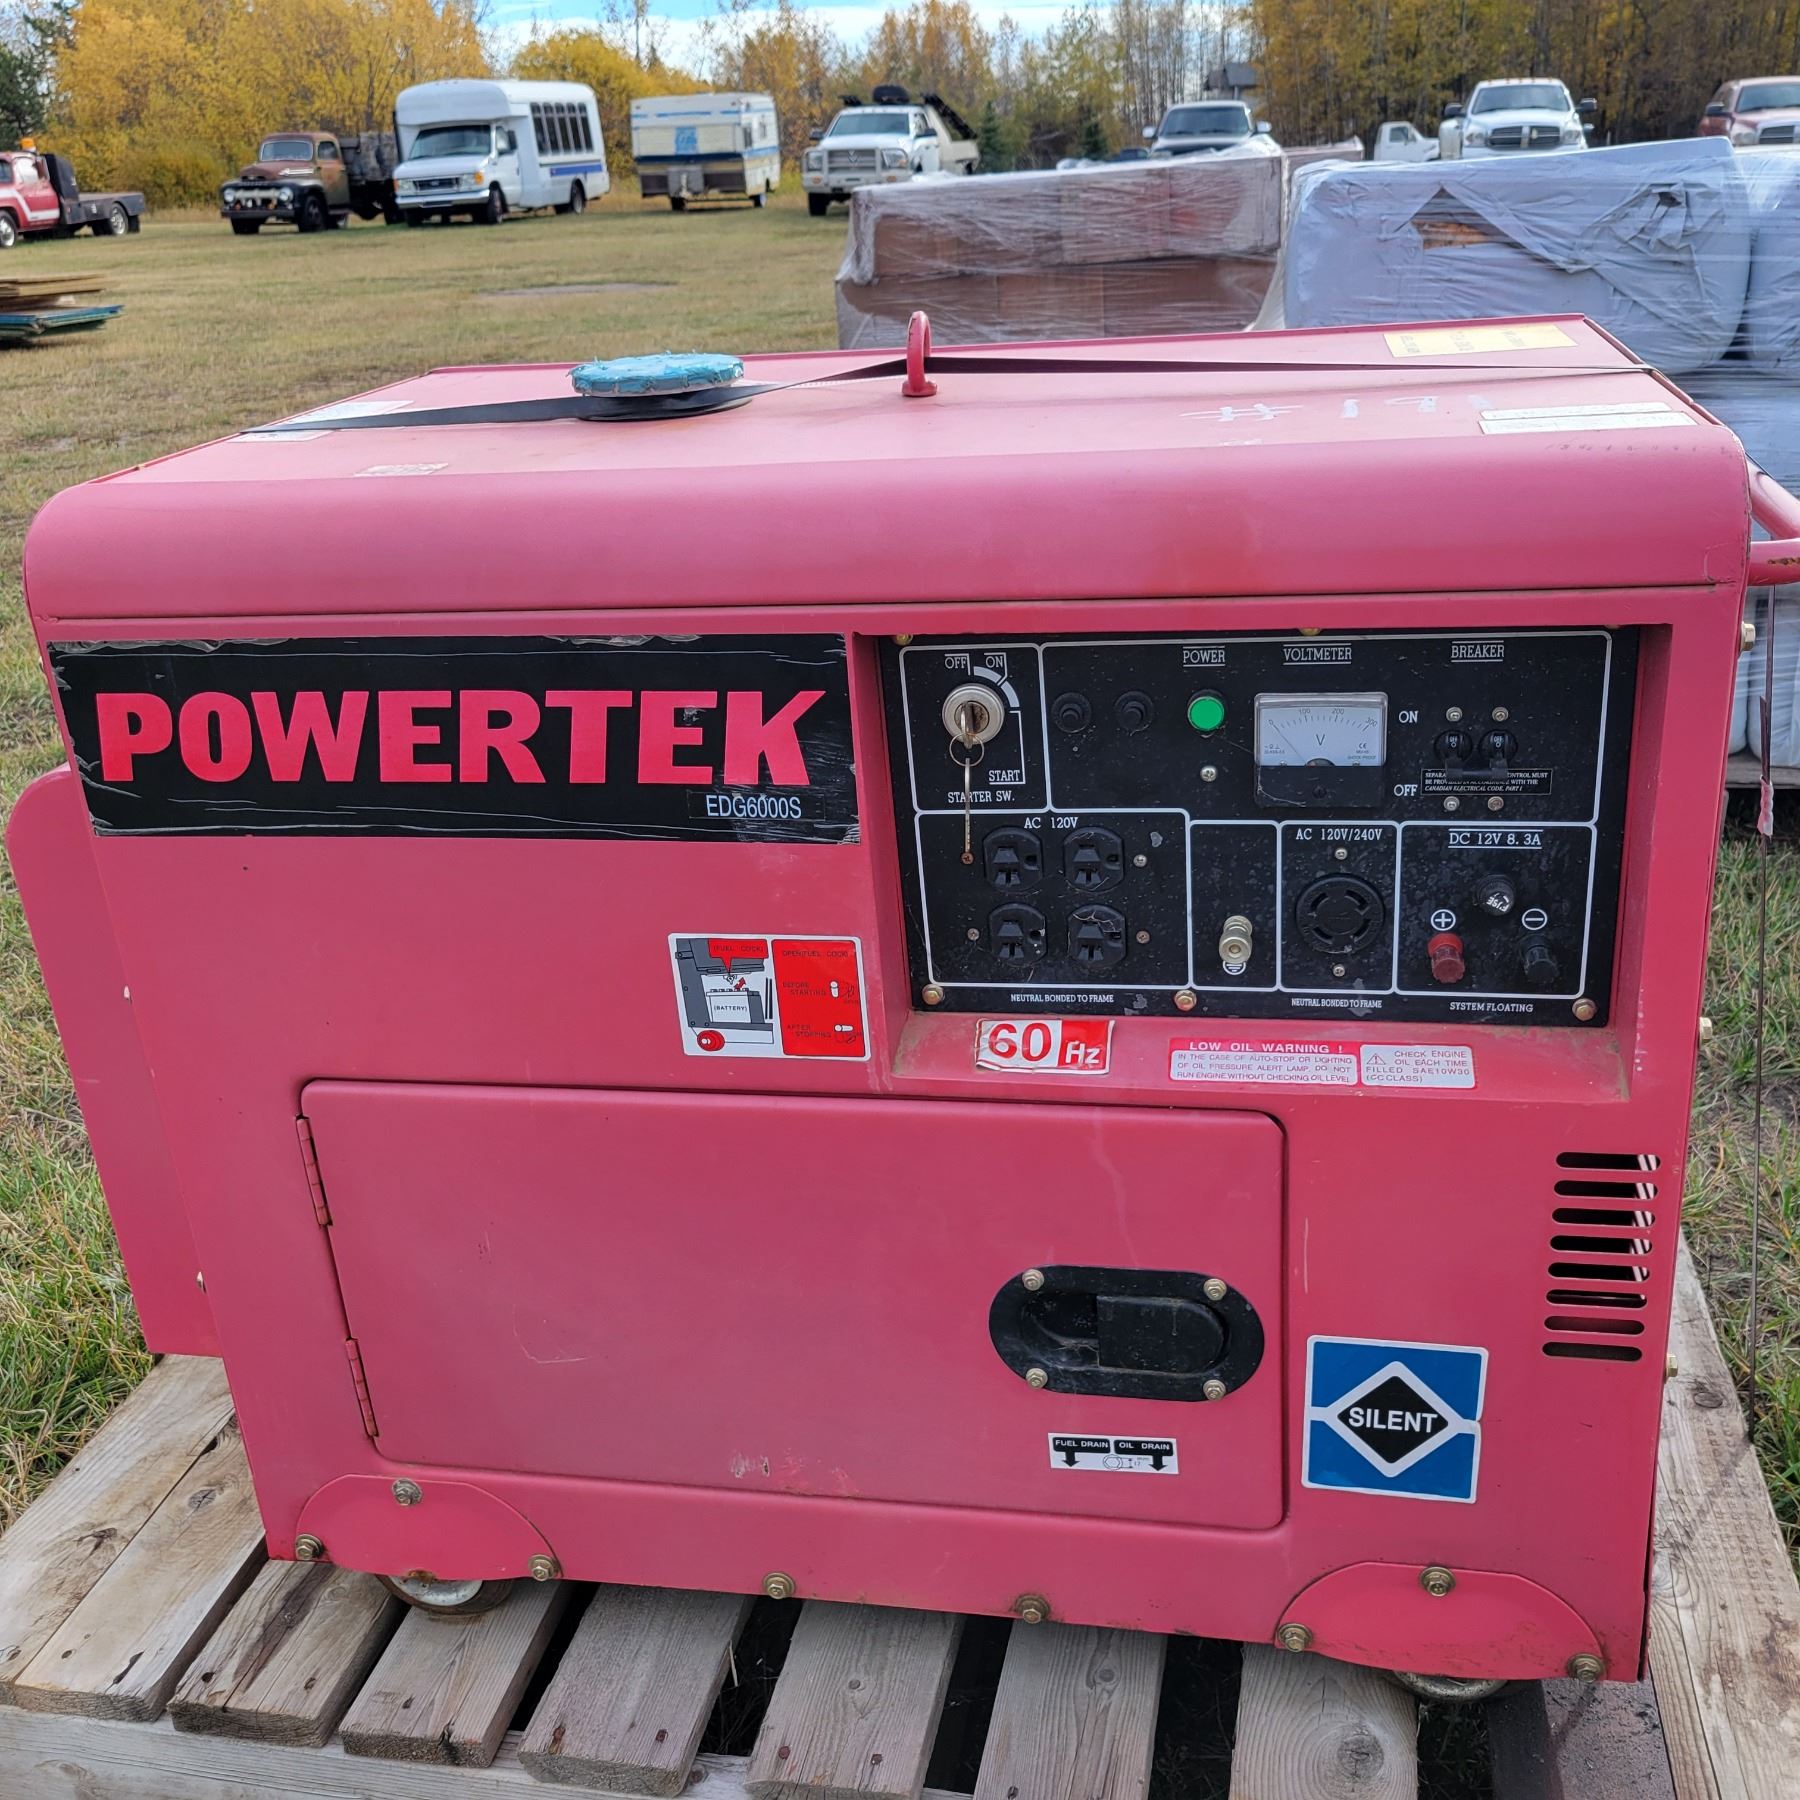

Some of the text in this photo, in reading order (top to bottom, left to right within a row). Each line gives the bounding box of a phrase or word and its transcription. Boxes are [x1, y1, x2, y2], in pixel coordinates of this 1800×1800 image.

[1183, 650, 1226, 664] POWER
[1283, 648, 1352, 661] VOLTMETER
[1451, 645, 1505, 659] BREAKER
[945, 656, 967, 669] OFF
[986, 656, 1003, 668] ON
[1398, 710, 1418, 724] ON
[96, 690, 826, 786] POWERTEK
[1316, 733, 1326, 746] V
[989, 770, 1020, 782] START
[996, 790, 1015, 802] SW.
[1394, 784, 1417, 797] OFF
[706, 795, 802, 819] EDG6000S
[1024, 816, 1079, 829] AC 120V
[1296, 828, 1383, 842] AC 120V/240V
[1450, 832, 1470, 846] DC
[1478, 832, 1502, 846] 12V
[1011, 994, 1114, 1003] NEUTRAL BONDED TO FRAME
[1291, 998, 1382, 1008] NEUTRAL BONDED TO FRAME
[1450, 1002, 1534, 1012] SYSTEM FLOATING
[988, 1022, 1100, 1064] 60 Hz
[1189, 1041, 1221, 1051] LOW
[1230, 1042, 1253, 1051] OIL
[1261, 1043, 1330, 1053] WARNING
[1249, 1055, 1295, 1063] AUTO-STOP
[1394, 1050, 1467, 1059] CHECK ENGINE
[1209, 1063, 1253, 1071] PRESSURE
[1257, 1064, 1283, 1072] ALERT
[1366, 1066, 1403, 1074] FILLED
[1310, 1074, 1325, 1082] OIL
[1326, 1074, 1349, 1083] LEVEL
[1348, 1407, 1439, 1433] SILENT
[1055, 1439, 1109, 1448] FUEL DRAIN
[1141, 1442, 1170, 1450] DRAIN
